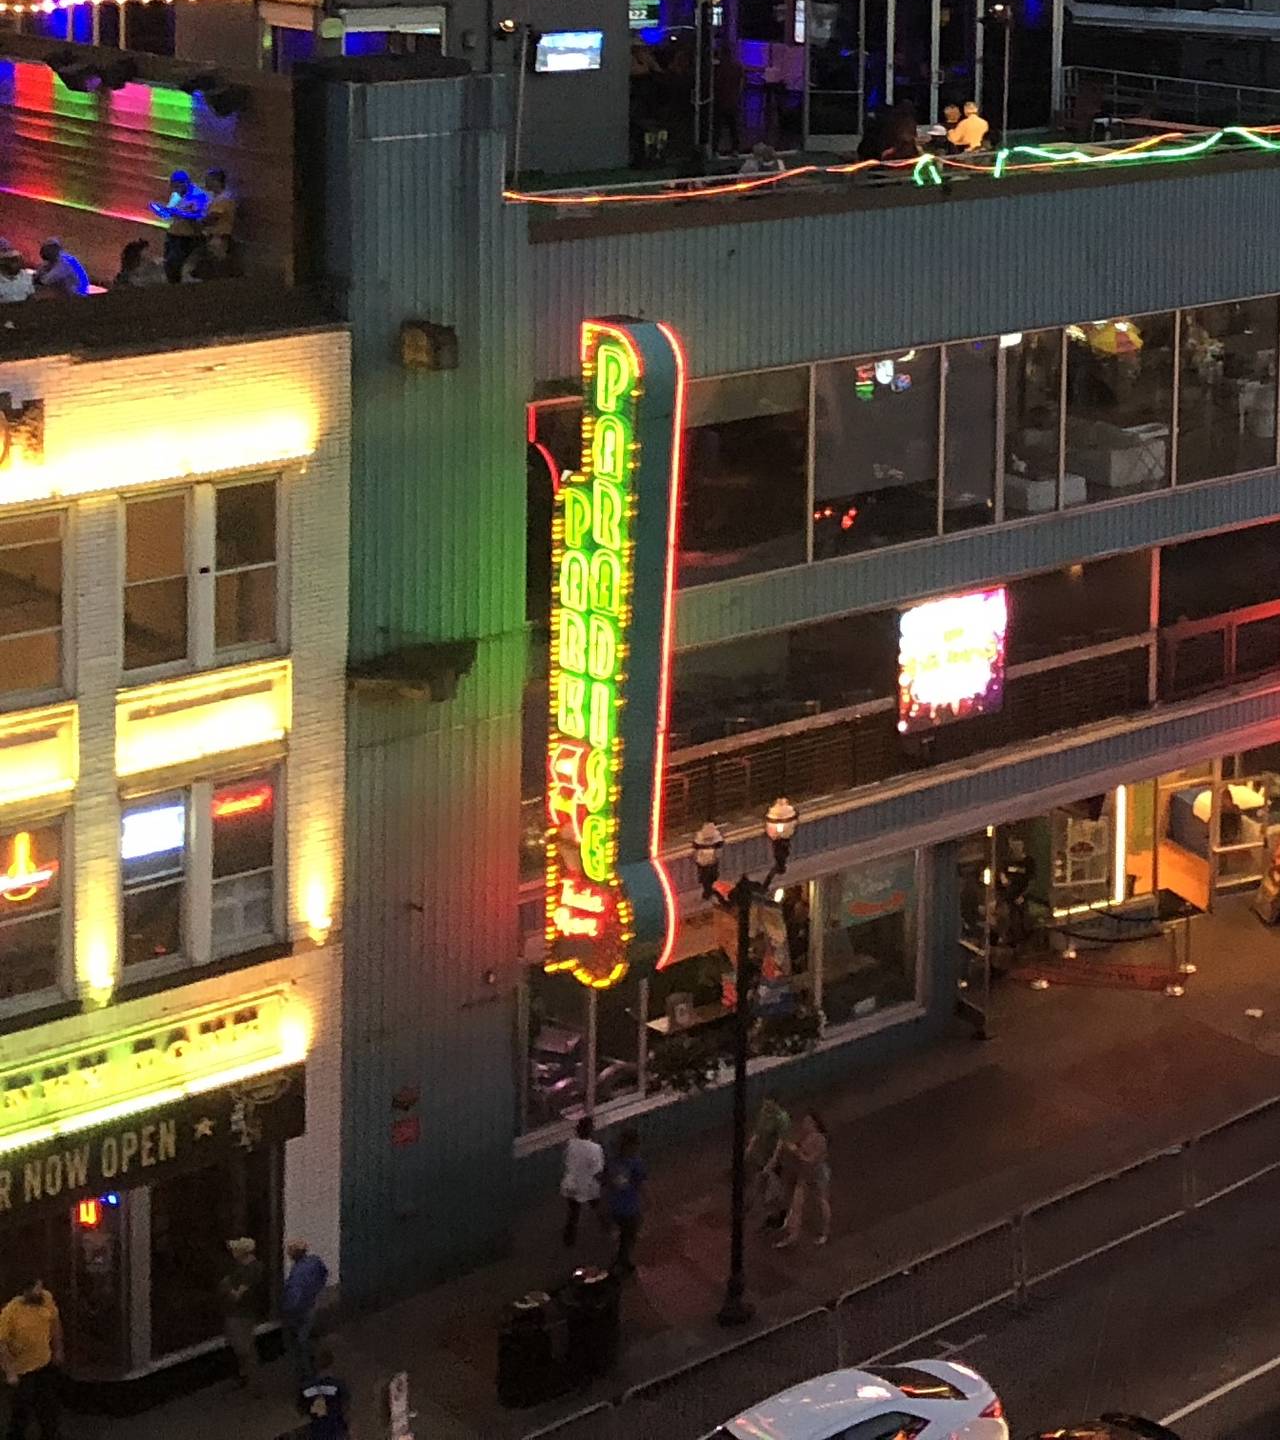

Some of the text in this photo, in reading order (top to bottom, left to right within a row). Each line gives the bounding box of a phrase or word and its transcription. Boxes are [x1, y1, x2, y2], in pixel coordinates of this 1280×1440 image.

[557, 487, 592, 739] PARK
[580, 343, 629, 882] PARADISE
[23, 1143, 91, 1204] NOW
[101, 1118, 178, 1179] OPEN
